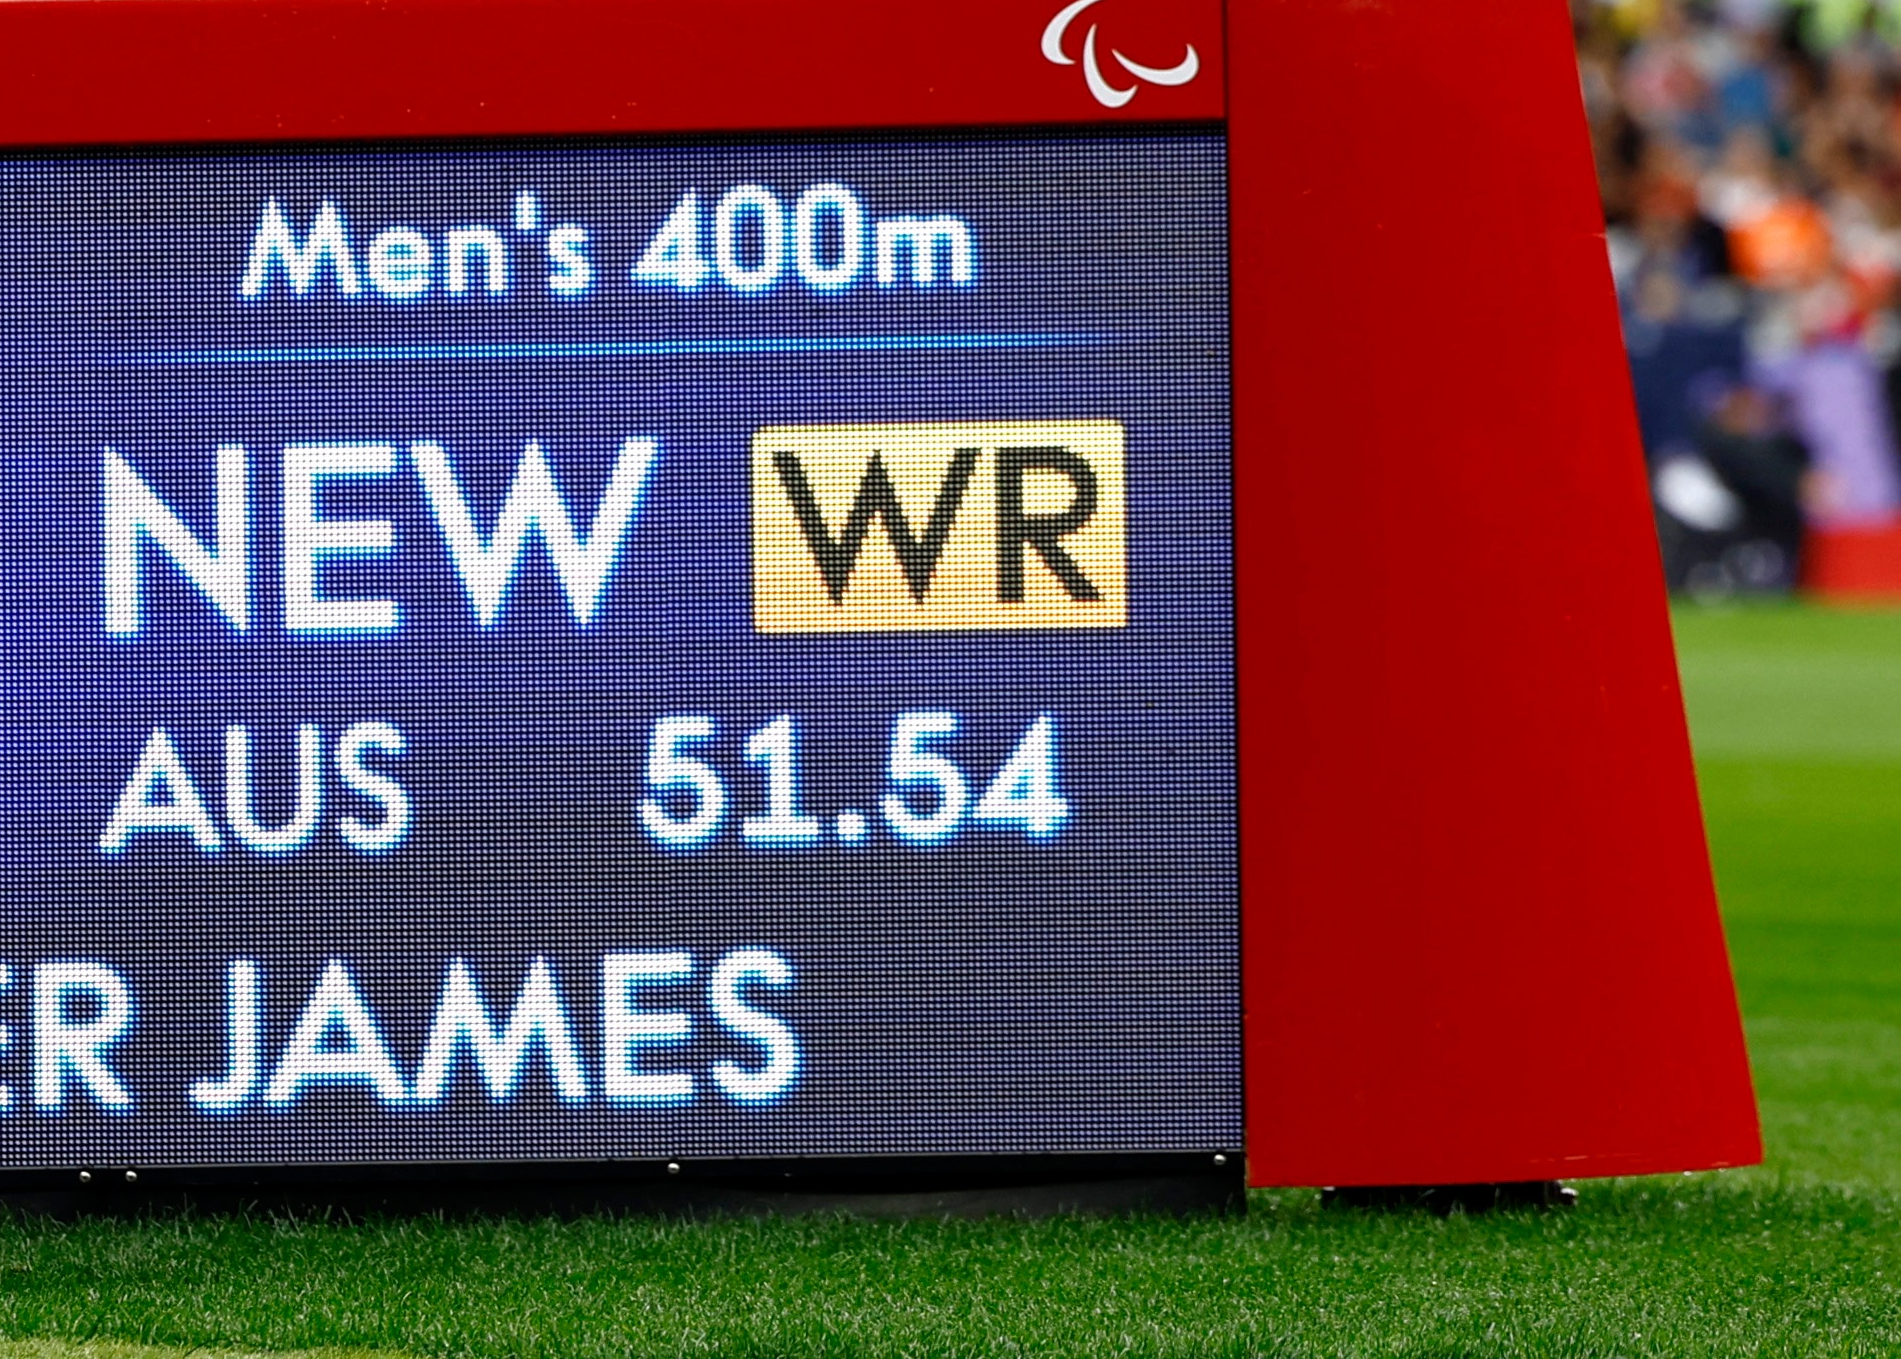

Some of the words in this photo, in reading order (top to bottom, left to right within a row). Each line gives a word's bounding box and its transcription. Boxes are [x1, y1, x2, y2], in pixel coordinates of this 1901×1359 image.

[237, 190, 601, 304] Men's
[629, 182, 983, 298] 400m
[99, 436, 661, 642] NEW
[771, 446, 1107, 608] WR
[97, 720, 417, 858] AUS
[637, 710, 1075, 852] 51.54
[185, 946, 807, 1118] JAMES
